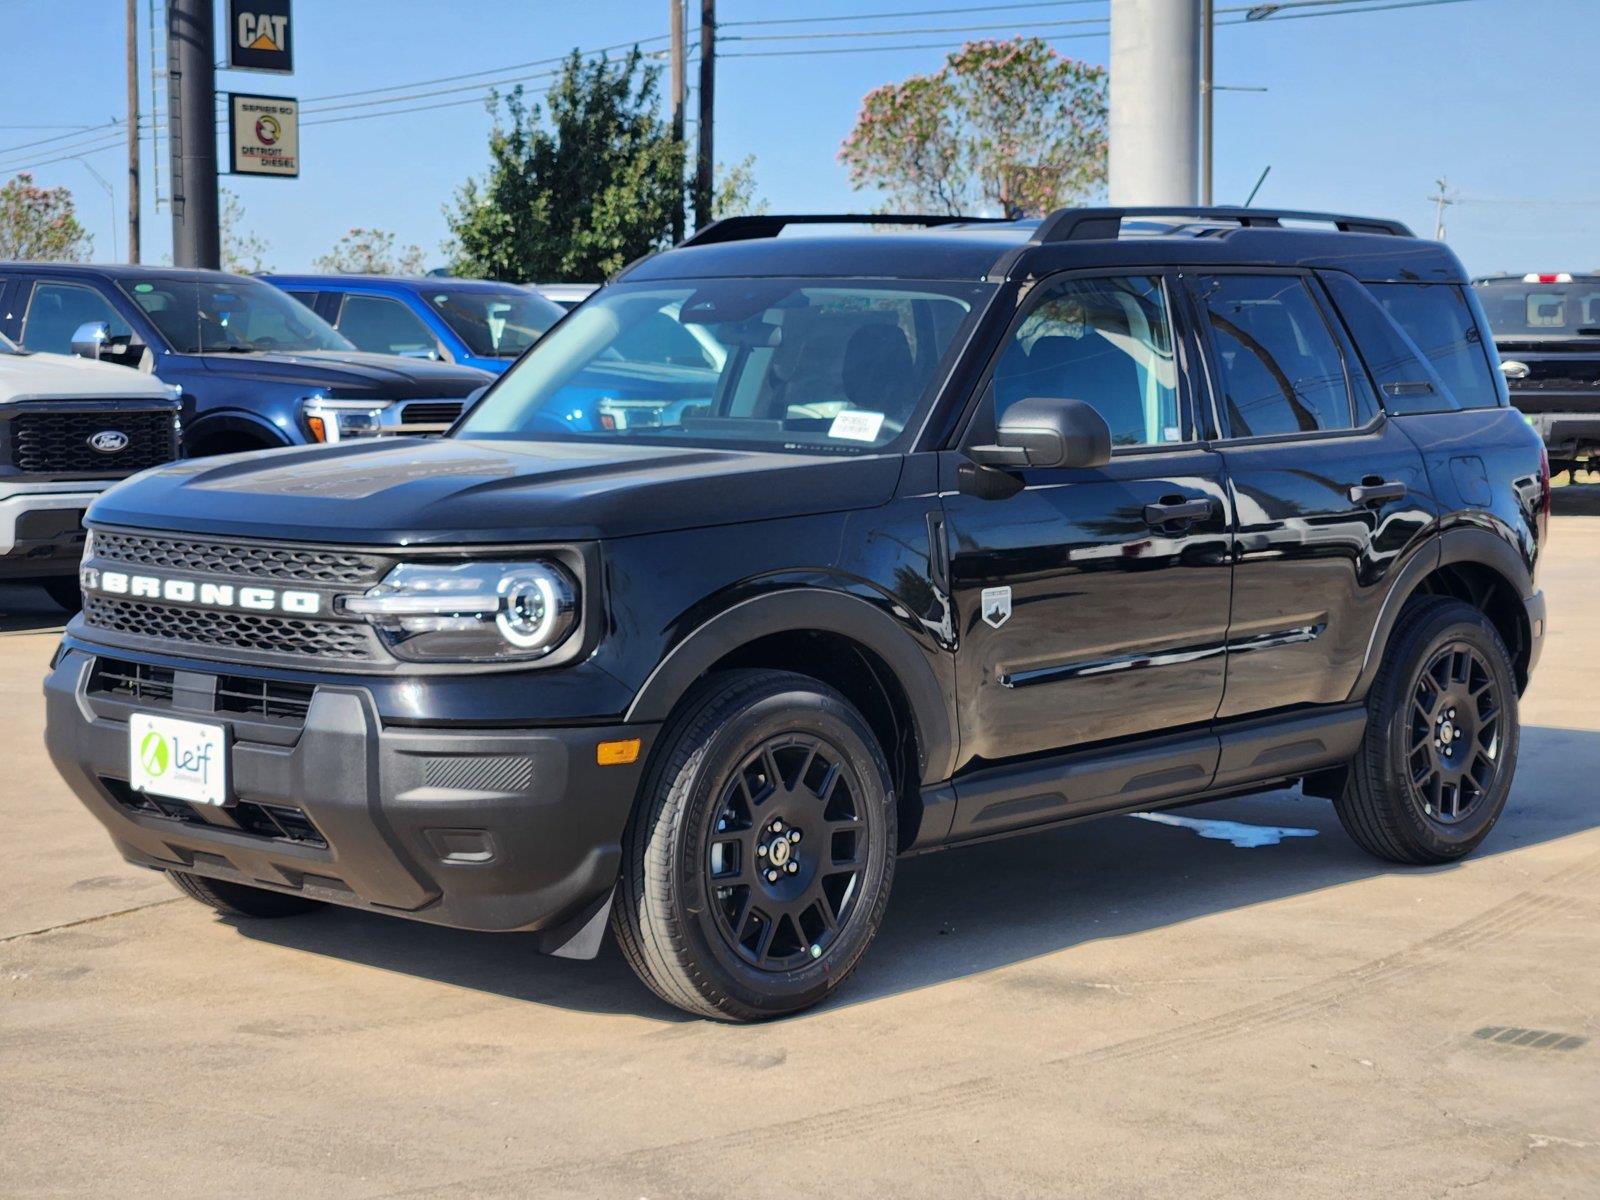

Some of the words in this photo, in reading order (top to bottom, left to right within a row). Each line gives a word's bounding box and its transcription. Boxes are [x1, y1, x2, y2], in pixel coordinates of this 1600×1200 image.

[238, 12, 288, 51] CAT
[241, 146, 282, 156] DETROIT
[261, 159, 296, 168] DIESEL
[101, 571, 321, 614] BRONCO
